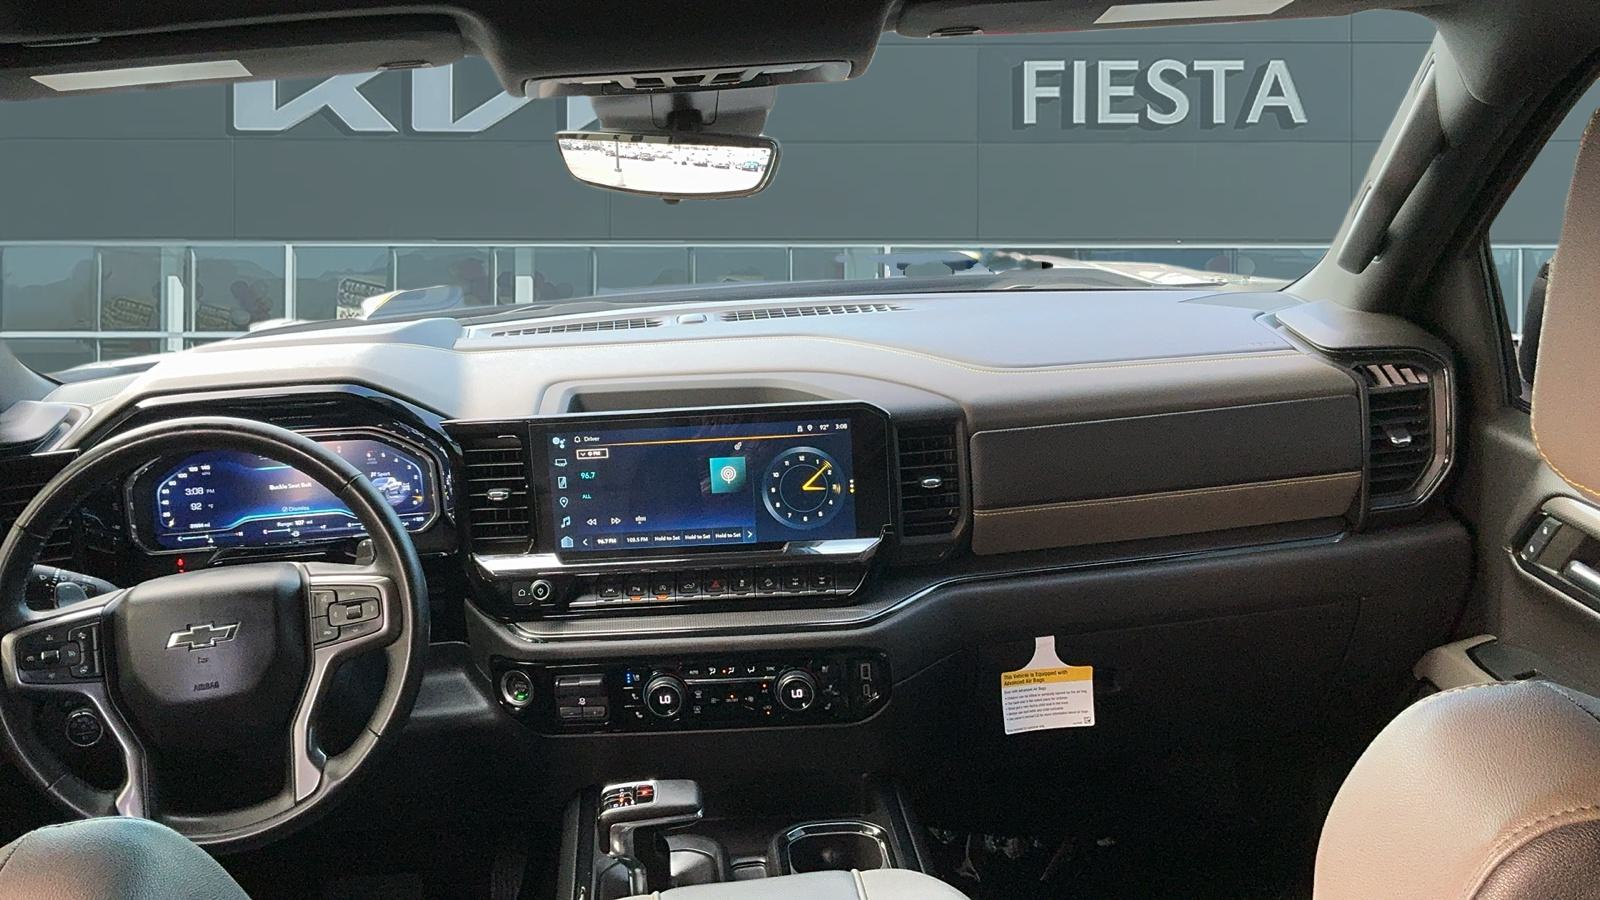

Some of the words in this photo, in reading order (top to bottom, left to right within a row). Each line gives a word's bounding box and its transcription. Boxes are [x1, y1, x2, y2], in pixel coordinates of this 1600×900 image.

[1022, 58, 1308, 125] FIESTA
[580, 472, 596, 480] 96.7
[184, 486, 204, 496] 3:08
[268, 483, 288, 491] Buckle
[190, 502, 203, 510] 92
[1035, 670, 1057, 678] Equipped
